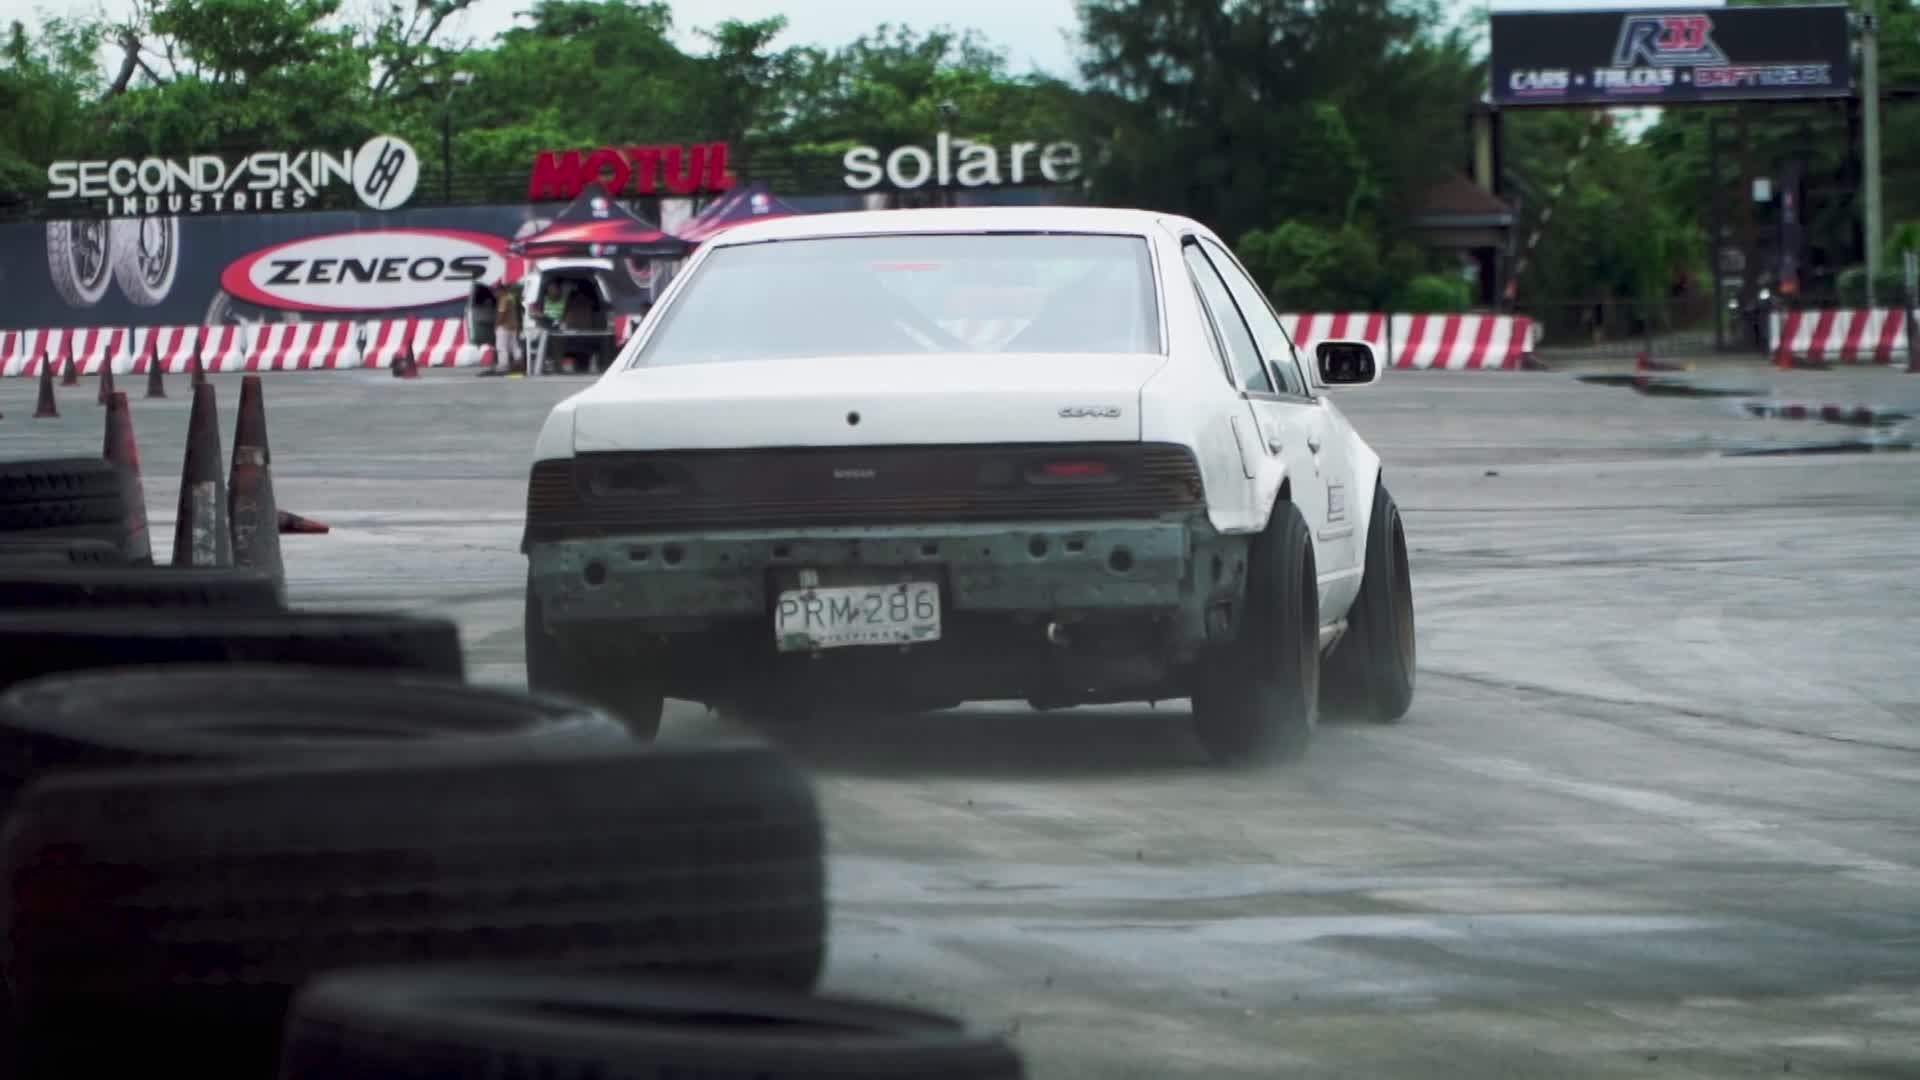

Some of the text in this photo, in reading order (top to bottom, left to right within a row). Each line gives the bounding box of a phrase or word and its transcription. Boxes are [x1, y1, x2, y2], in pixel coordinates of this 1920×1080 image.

[529, 142, 737, 198] MOTUL
[842, 131, 1082, 189] solare
[107, 190, 306, 215] INDUSTRIES
[264, 256, 489, 285] ZENEOS
